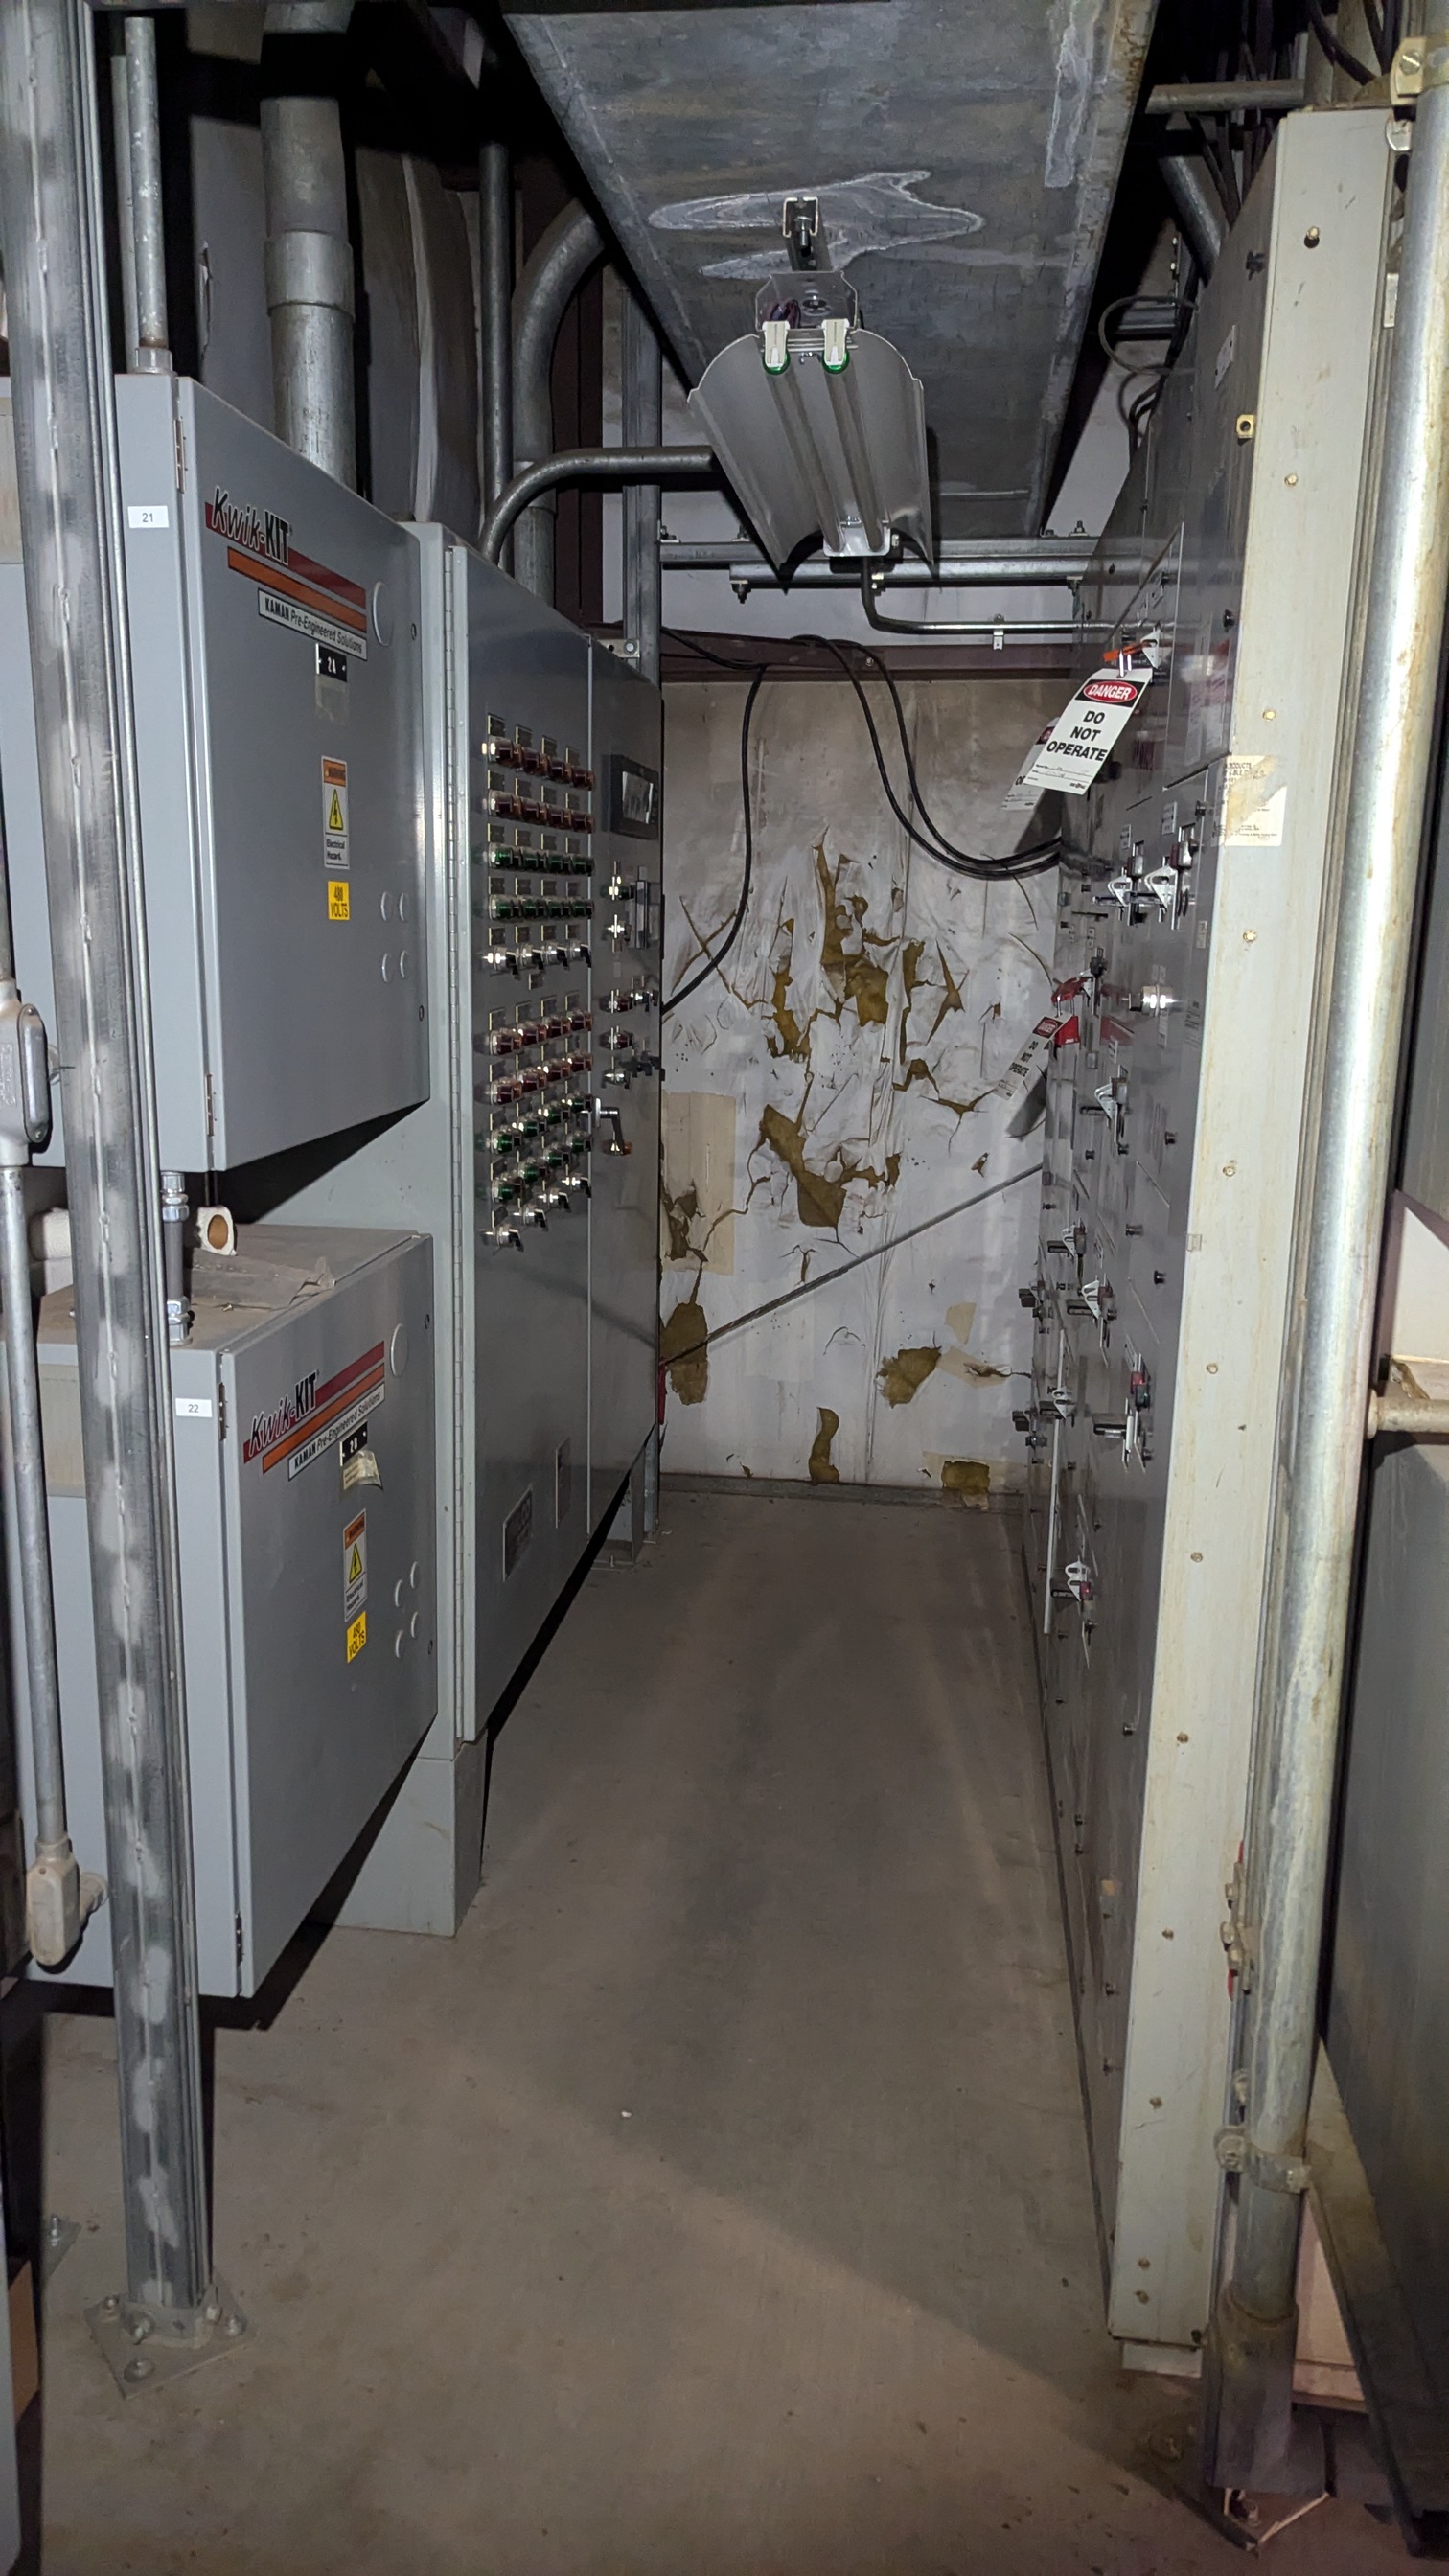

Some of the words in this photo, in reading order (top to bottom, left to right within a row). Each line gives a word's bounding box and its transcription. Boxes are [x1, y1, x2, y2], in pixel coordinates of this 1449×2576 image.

[142, 512, 153, 523] 21
[264, 597, 289, 621] KAMAN
[290, 610, 336, 641] Pre-Engineered
[337, 632, 362, 654] Solutions
[1088, 683, 1132, 701] DANGER
[1083, 710, 1105, 724] DO
[1070, 726, 1101, 742] NOT
[1046, 741, 1108, 762] OPERATE
[334, 886, 343, 902] 480
[330, 902, 348, 918] VOLTS
[1021, 1052, 1033, 1064] NOT
[188, 1404, 199, 1414] 22
[294, 1442, 316, 1469] KAMAN
[317, 1411, 357, 1451] Pre-Engineered
[358, 1392, 380, 1415] Solutions
[349, 1630, 364, 1657] VOLTS
